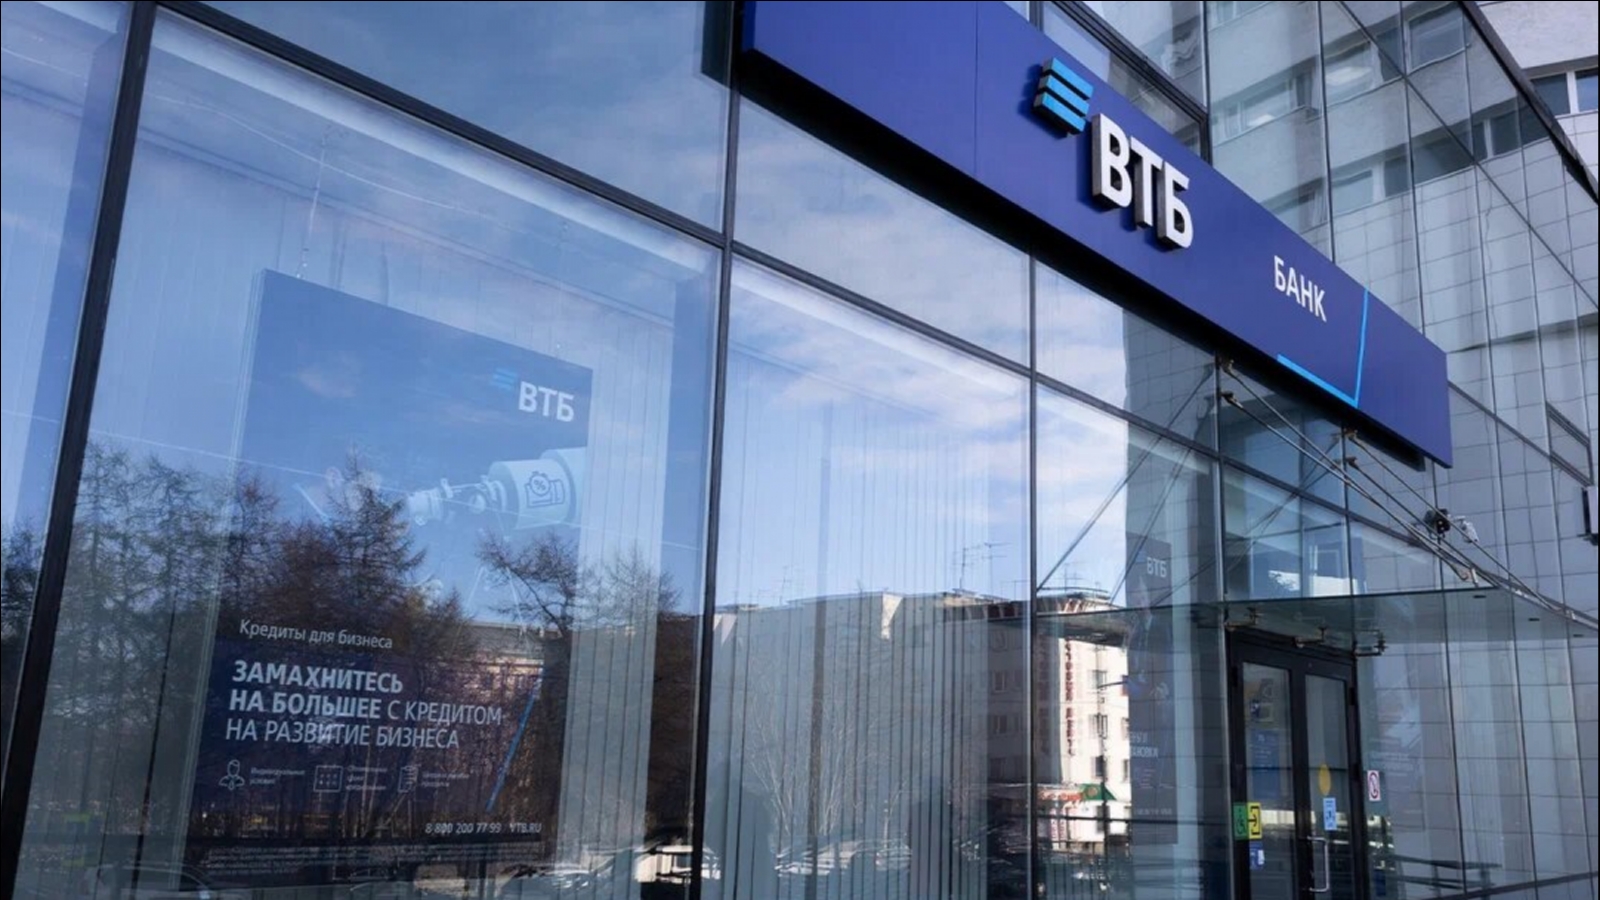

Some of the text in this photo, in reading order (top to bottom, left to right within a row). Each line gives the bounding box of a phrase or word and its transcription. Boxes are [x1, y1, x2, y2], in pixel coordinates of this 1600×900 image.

[1092, 112, 1194, 248] ВТБ
[1274, 255, 1327, 323] БАНК
[519, 380, 574, 422] ВТБ
[239, 619, 393, 649] Кредиты для бизнеса
[232, 659, 403, 693] ЗАМАХНИТЕСЬ
[229, 688, 502, 726] НА БОЛЬШЕЕ С КРЕДИТОМ
[226, 718, 459, 749] НА РАЗВИТИЕ БИЗНЕСА
